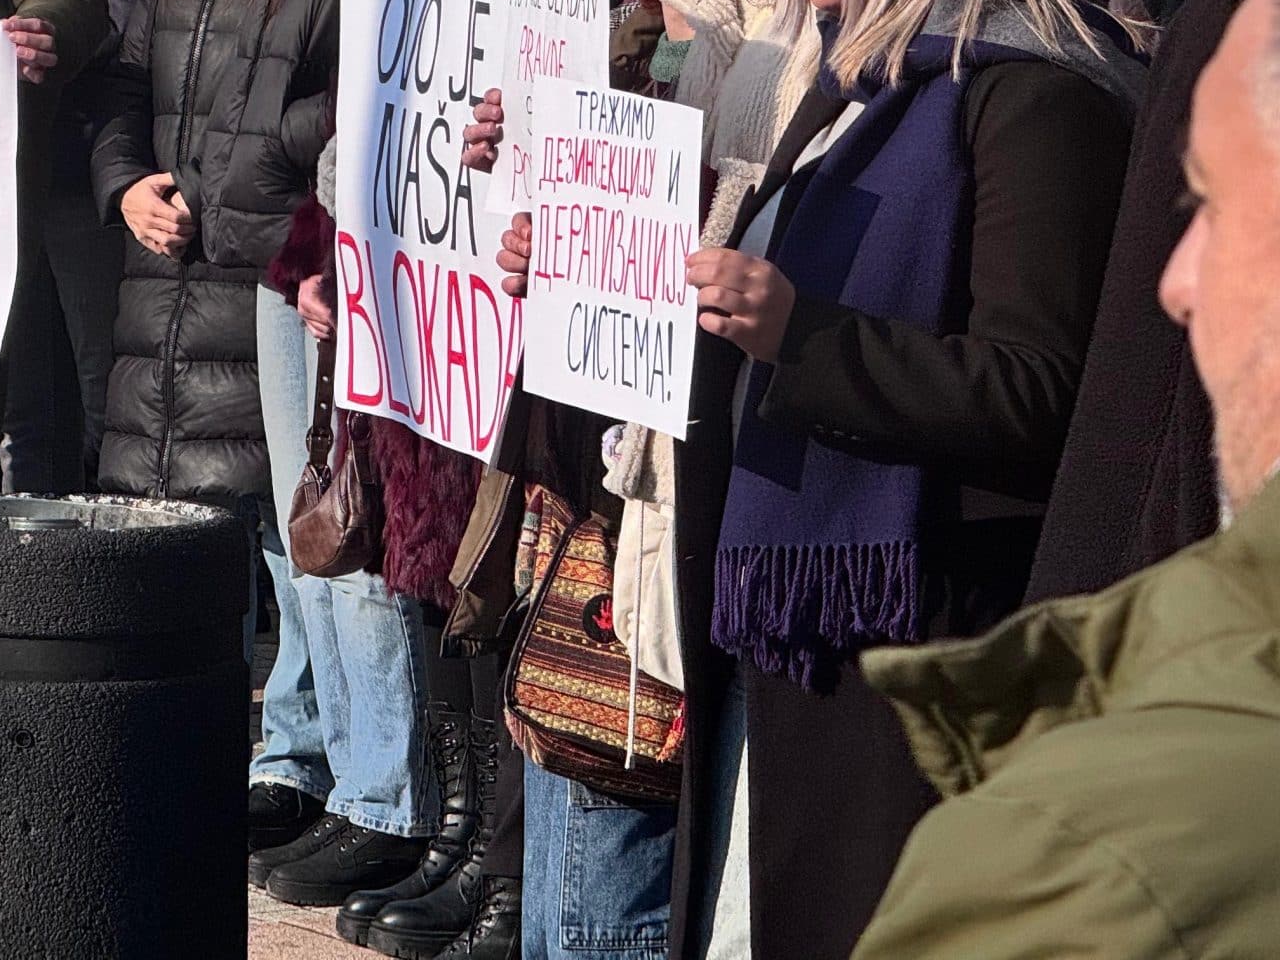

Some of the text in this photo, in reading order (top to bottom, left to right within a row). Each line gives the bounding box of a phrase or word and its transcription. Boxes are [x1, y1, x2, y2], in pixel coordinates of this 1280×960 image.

[575, 90, 656, 142] ТРАЖИМО
[373, 100, 479, 257] NAŠA
[538, 135, 680, 205] ДЕЗИНСЕКЦИЈУ И
[534, 204, 693, 309] ДЕРАТИЗАЦИЈУ
[336, 230, 526, 454] BLOKADA
[566, 302, 674, 403] СИСТЕМА!
